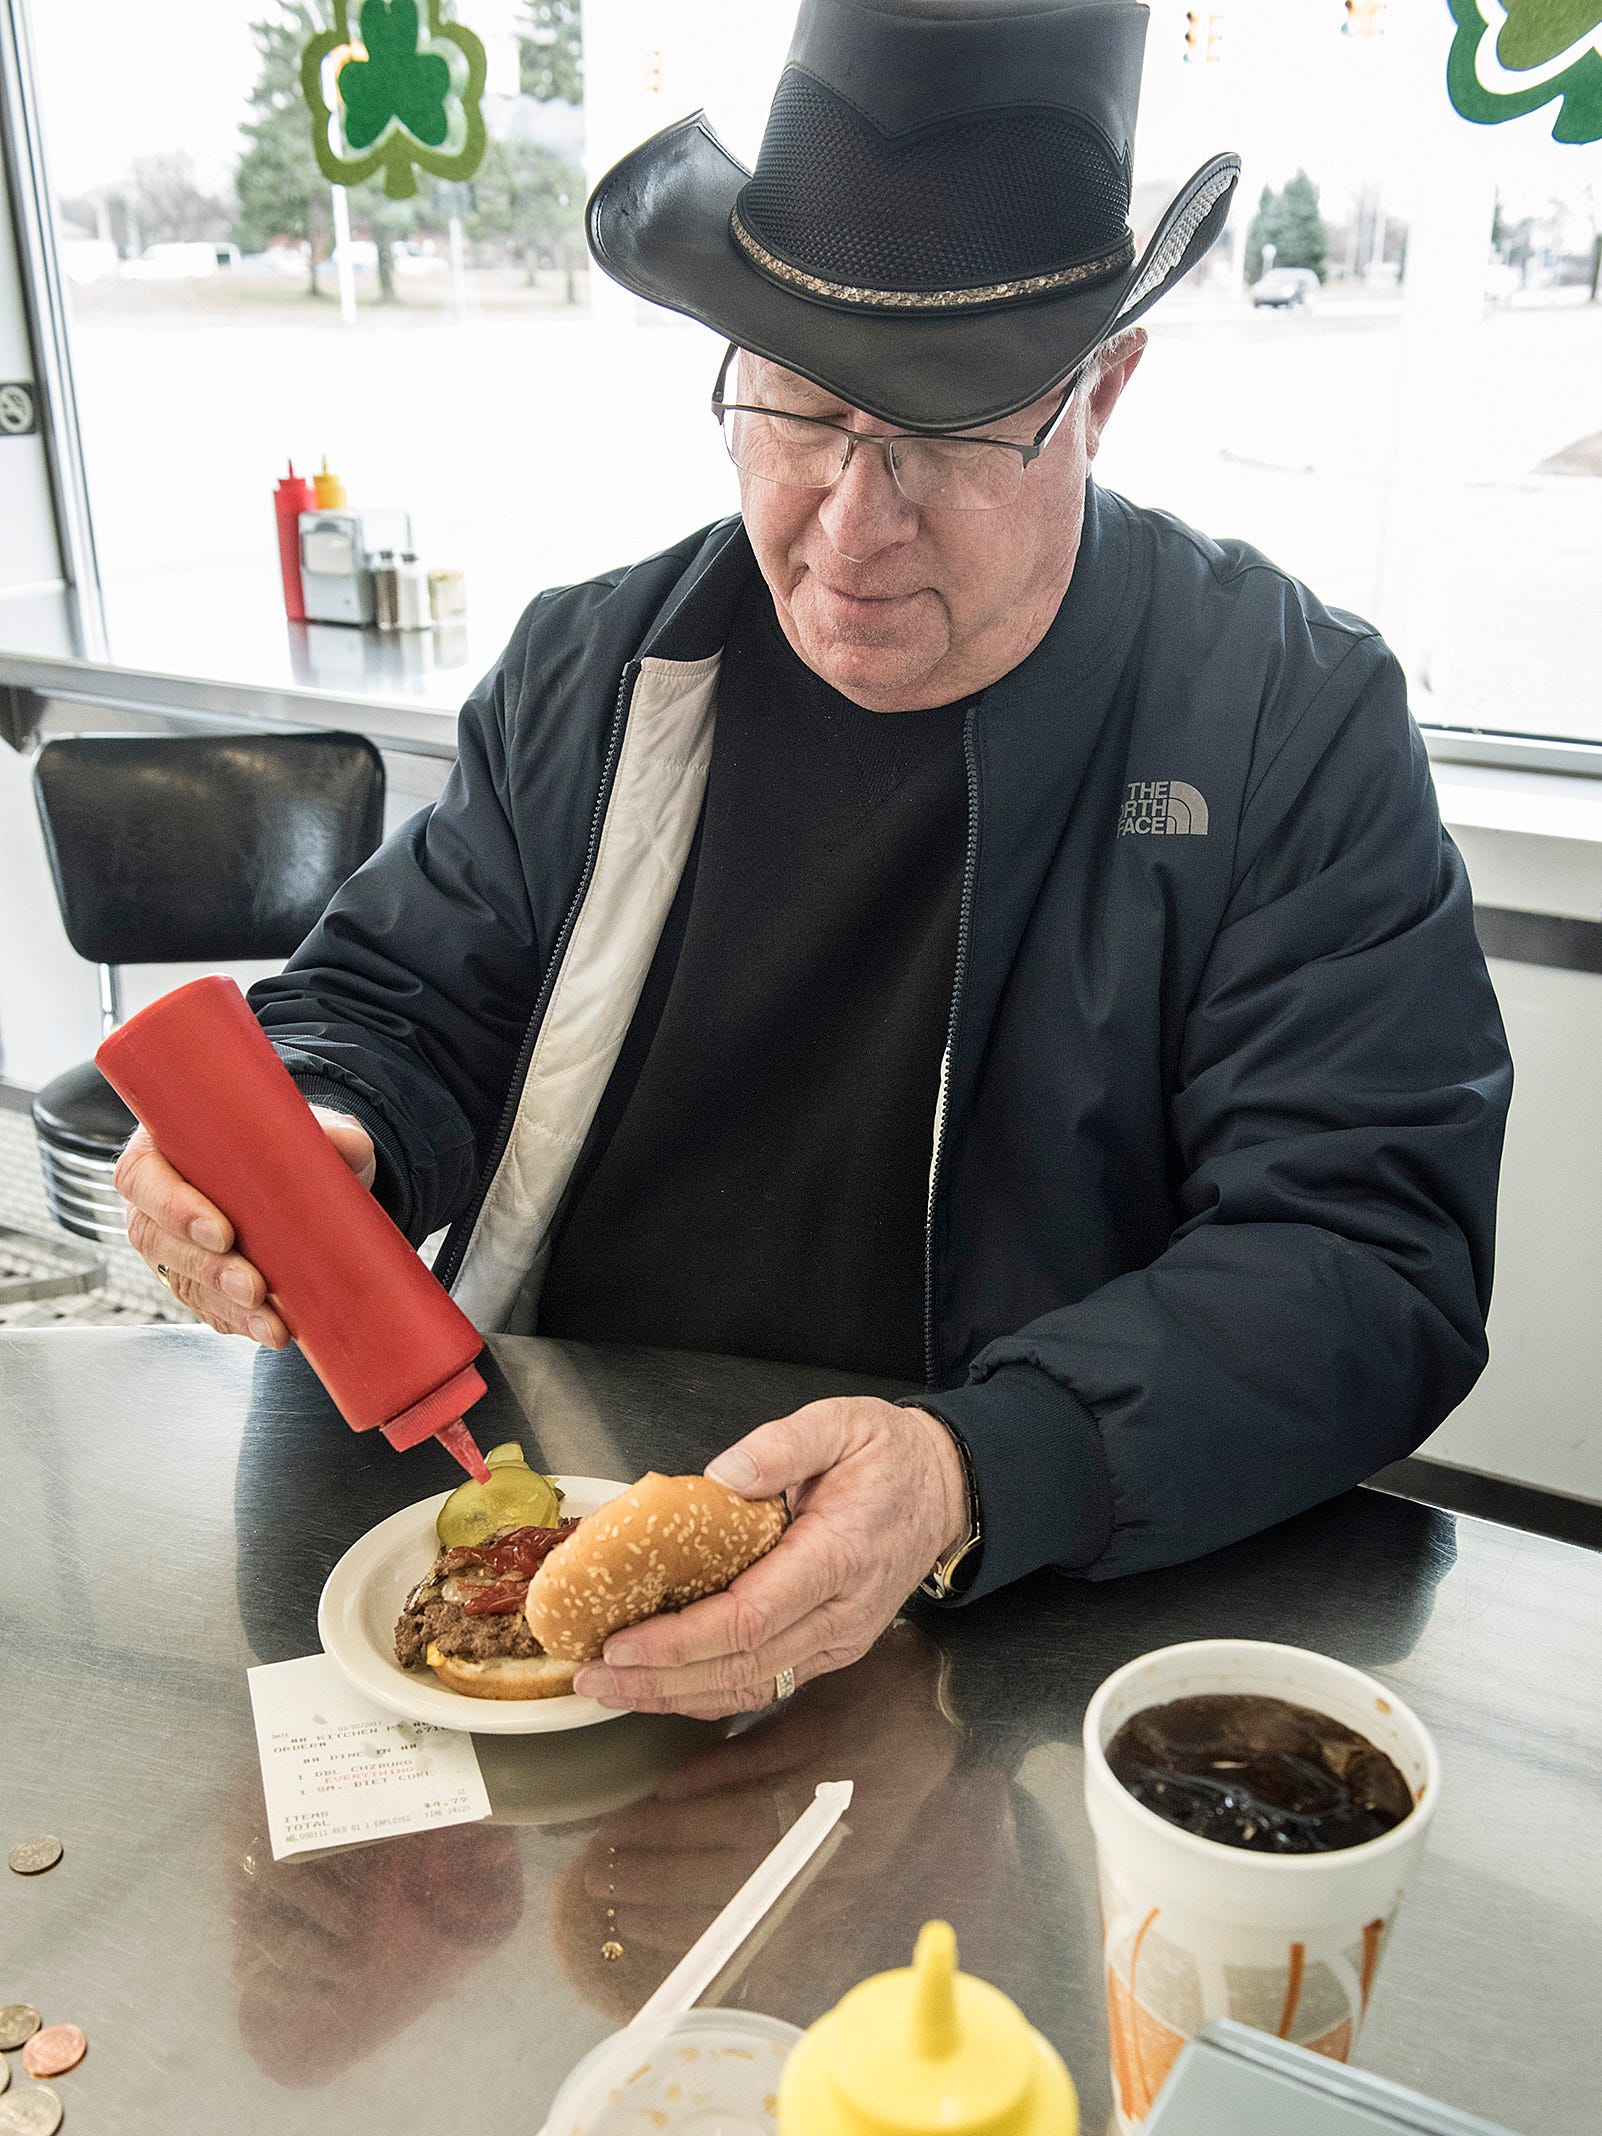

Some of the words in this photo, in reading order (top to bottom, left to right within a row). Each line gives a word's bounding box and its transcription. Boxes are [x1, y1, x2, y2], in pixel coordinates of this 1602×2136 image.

[1128, 781, 1169, 800] THE
[1119, 798, 1168, 819] RTH
[1117, 816, 1166, 839] FACE
[317, 1727, 378, 1741] KITCHEN
[330, 1751, 365, 1762] DINE
[376, 1747, 391, 1756] IN
[314, 1768, 338, 1778] DBL
[323, 1766, 416, 1784] EVERYTHING
[353, 1777, 388, 1788] DIET
[283, 1811, 330, 1824] ITEMS
[286, 1821, 331, 1833] TOTAL
